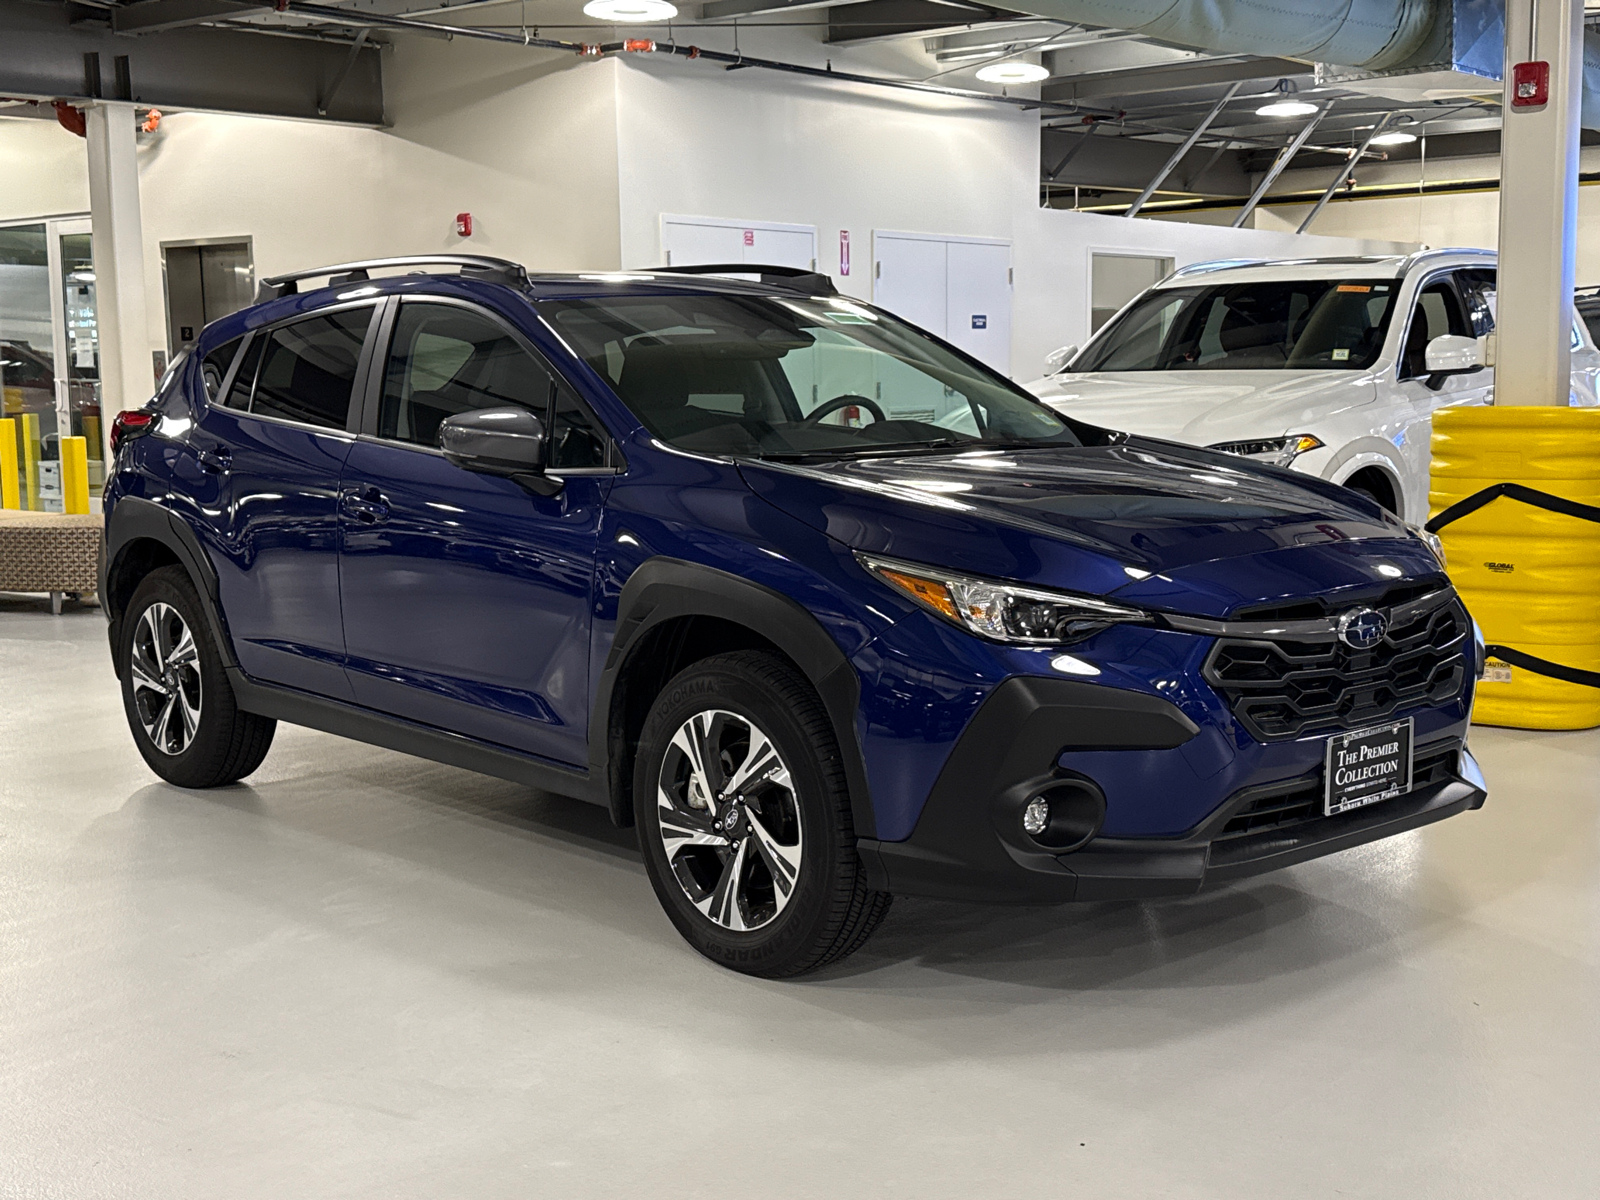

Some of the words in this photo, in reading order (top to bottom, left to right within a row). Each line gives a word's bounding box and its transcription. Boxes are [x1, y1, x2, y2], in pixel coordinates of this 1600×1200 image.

[184, 328, 190, 338] 2
[1484, 661, 1511, 669] CAUTION
[656, 680, 714, 720] YOKOHAMA
[1337, 750, 1359, 767] THE
[1359, 742, 1399, 761] PREMIER
[1335, 759, 1399, 786] COLLECTION
[1363, 794, 1380, 805] White
[1381, 789, 1400, 800] Plains
